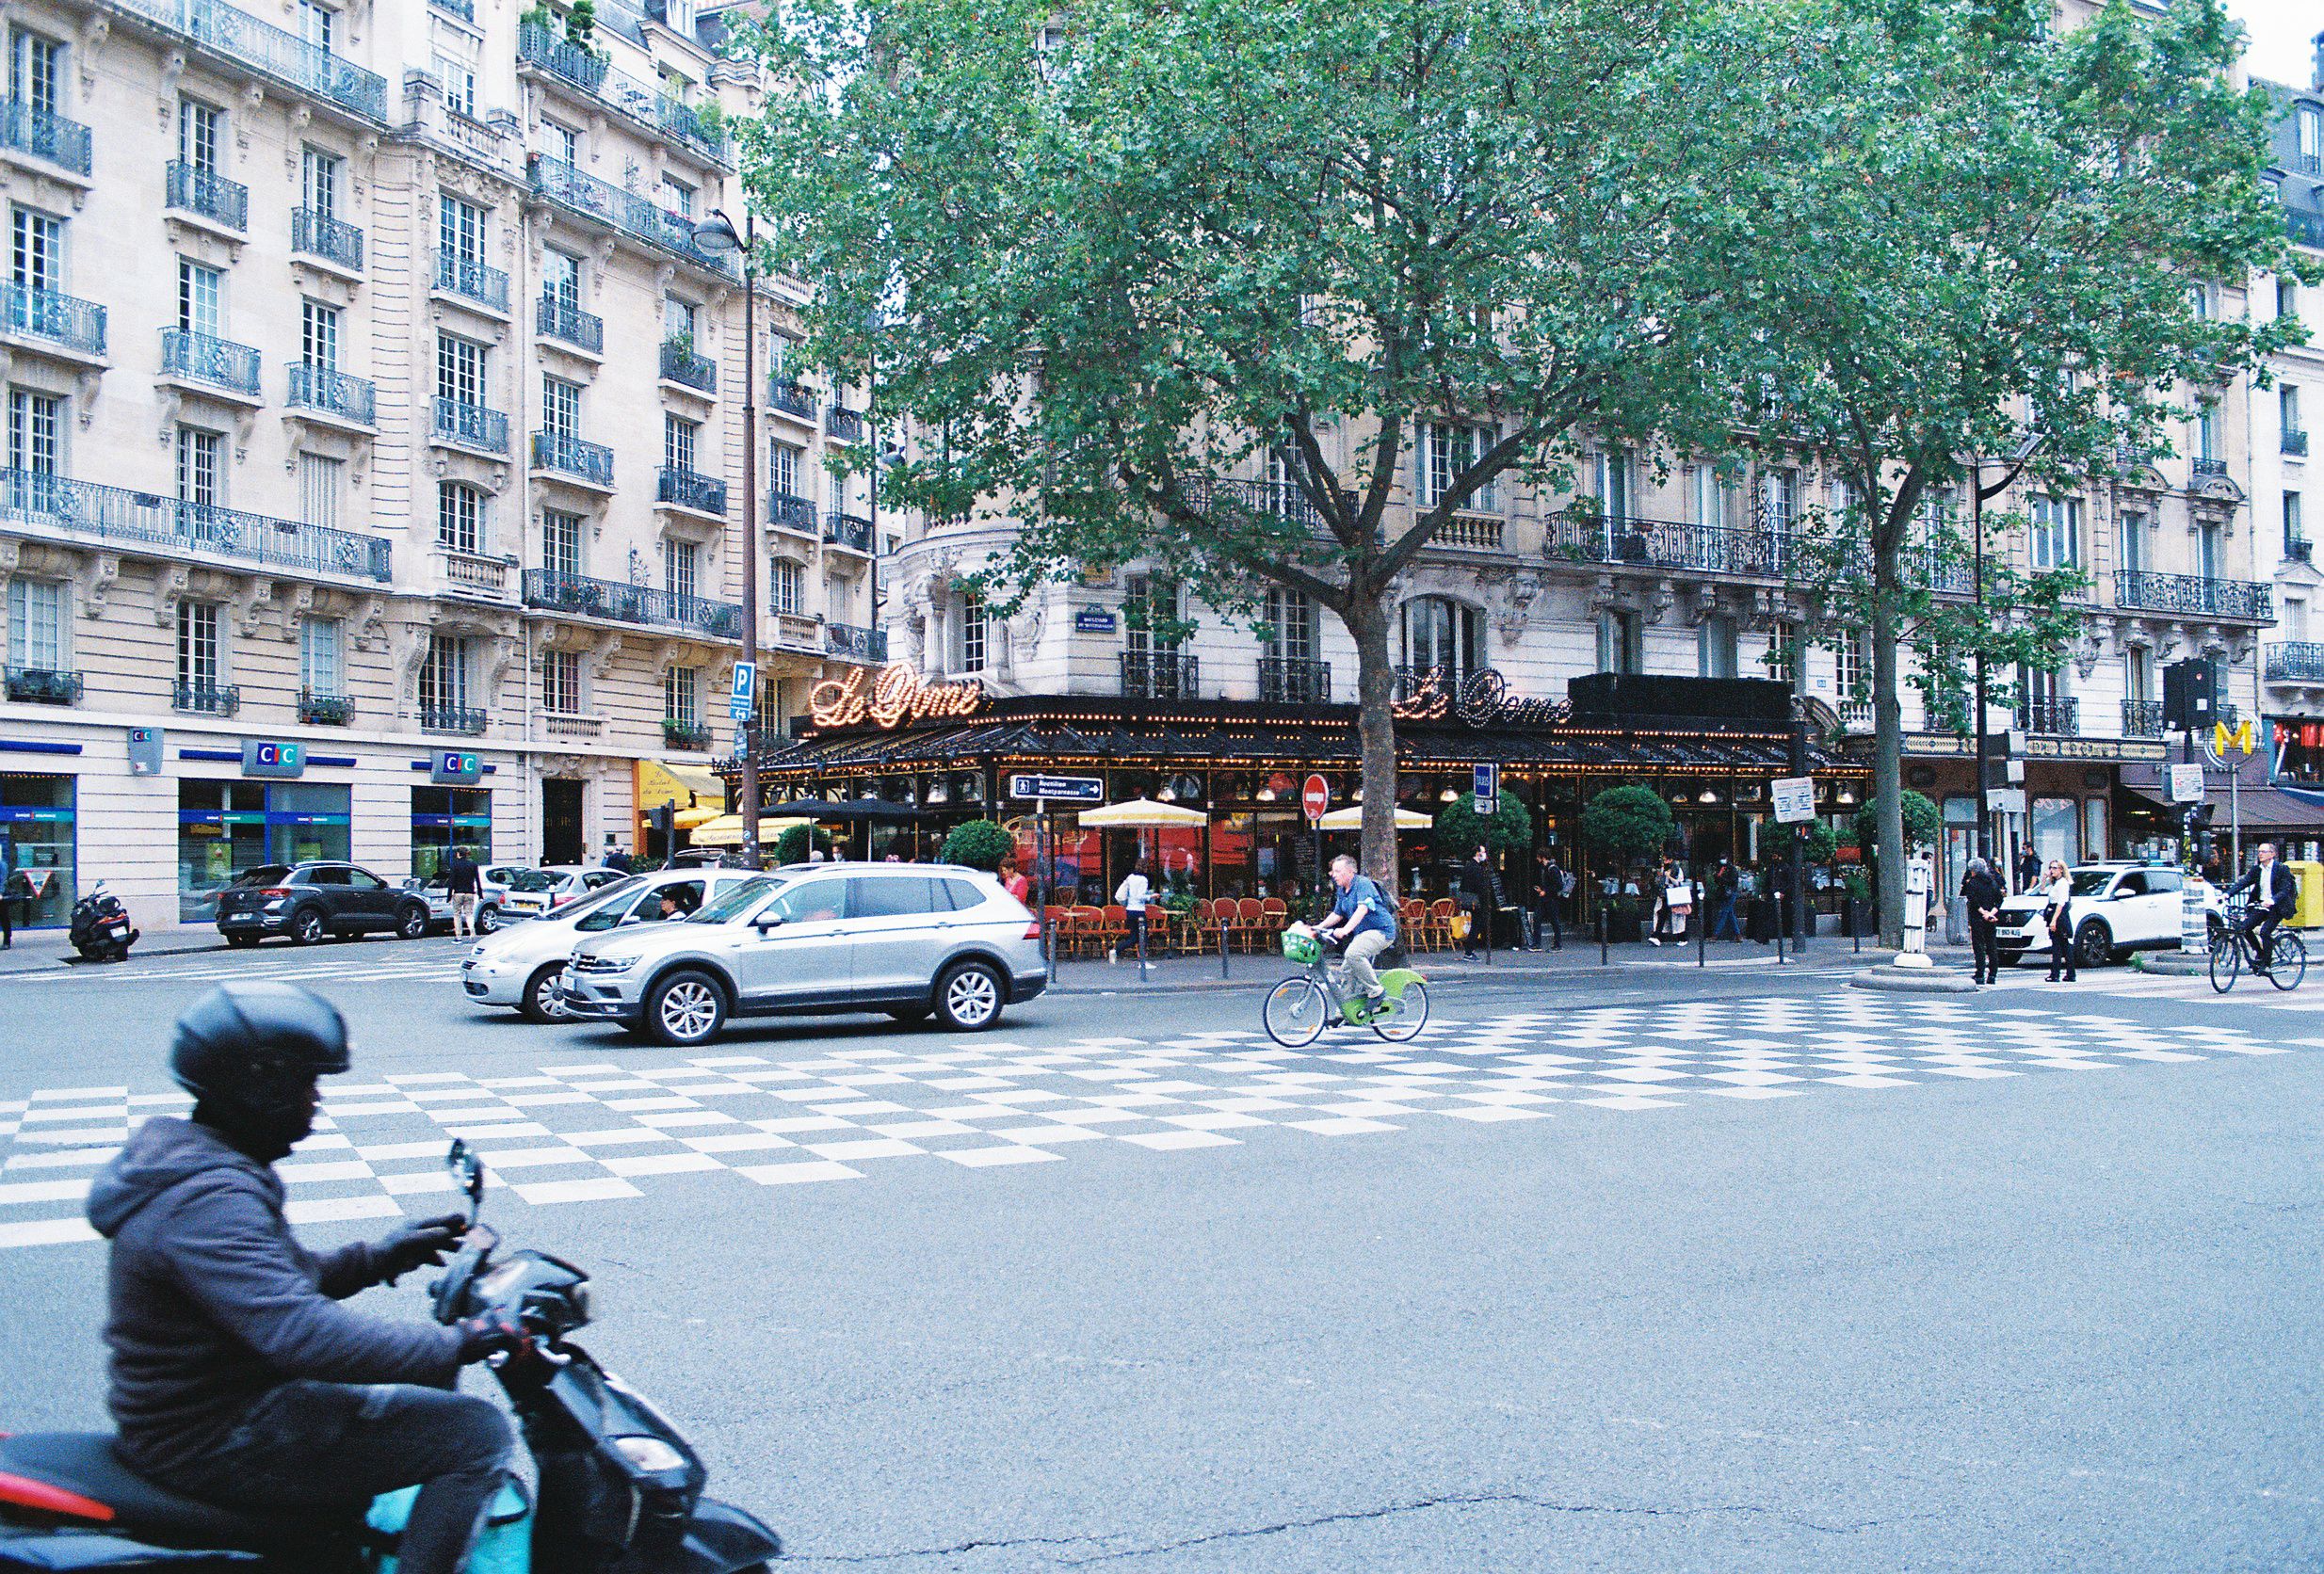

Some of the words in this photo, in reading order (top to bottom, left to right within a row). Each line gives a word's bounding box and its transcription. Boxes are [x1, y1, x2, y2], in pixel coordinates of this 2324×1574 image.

[736, 668, 748, 692] P
[134, 731, 151, 741] CIC
[2215, 718, 2252, 757] M
[260, 747, 294, 763] CIC
[446, 756, 474, 771] CIC
[1038, 787, 1080, 796] Montparnasse
